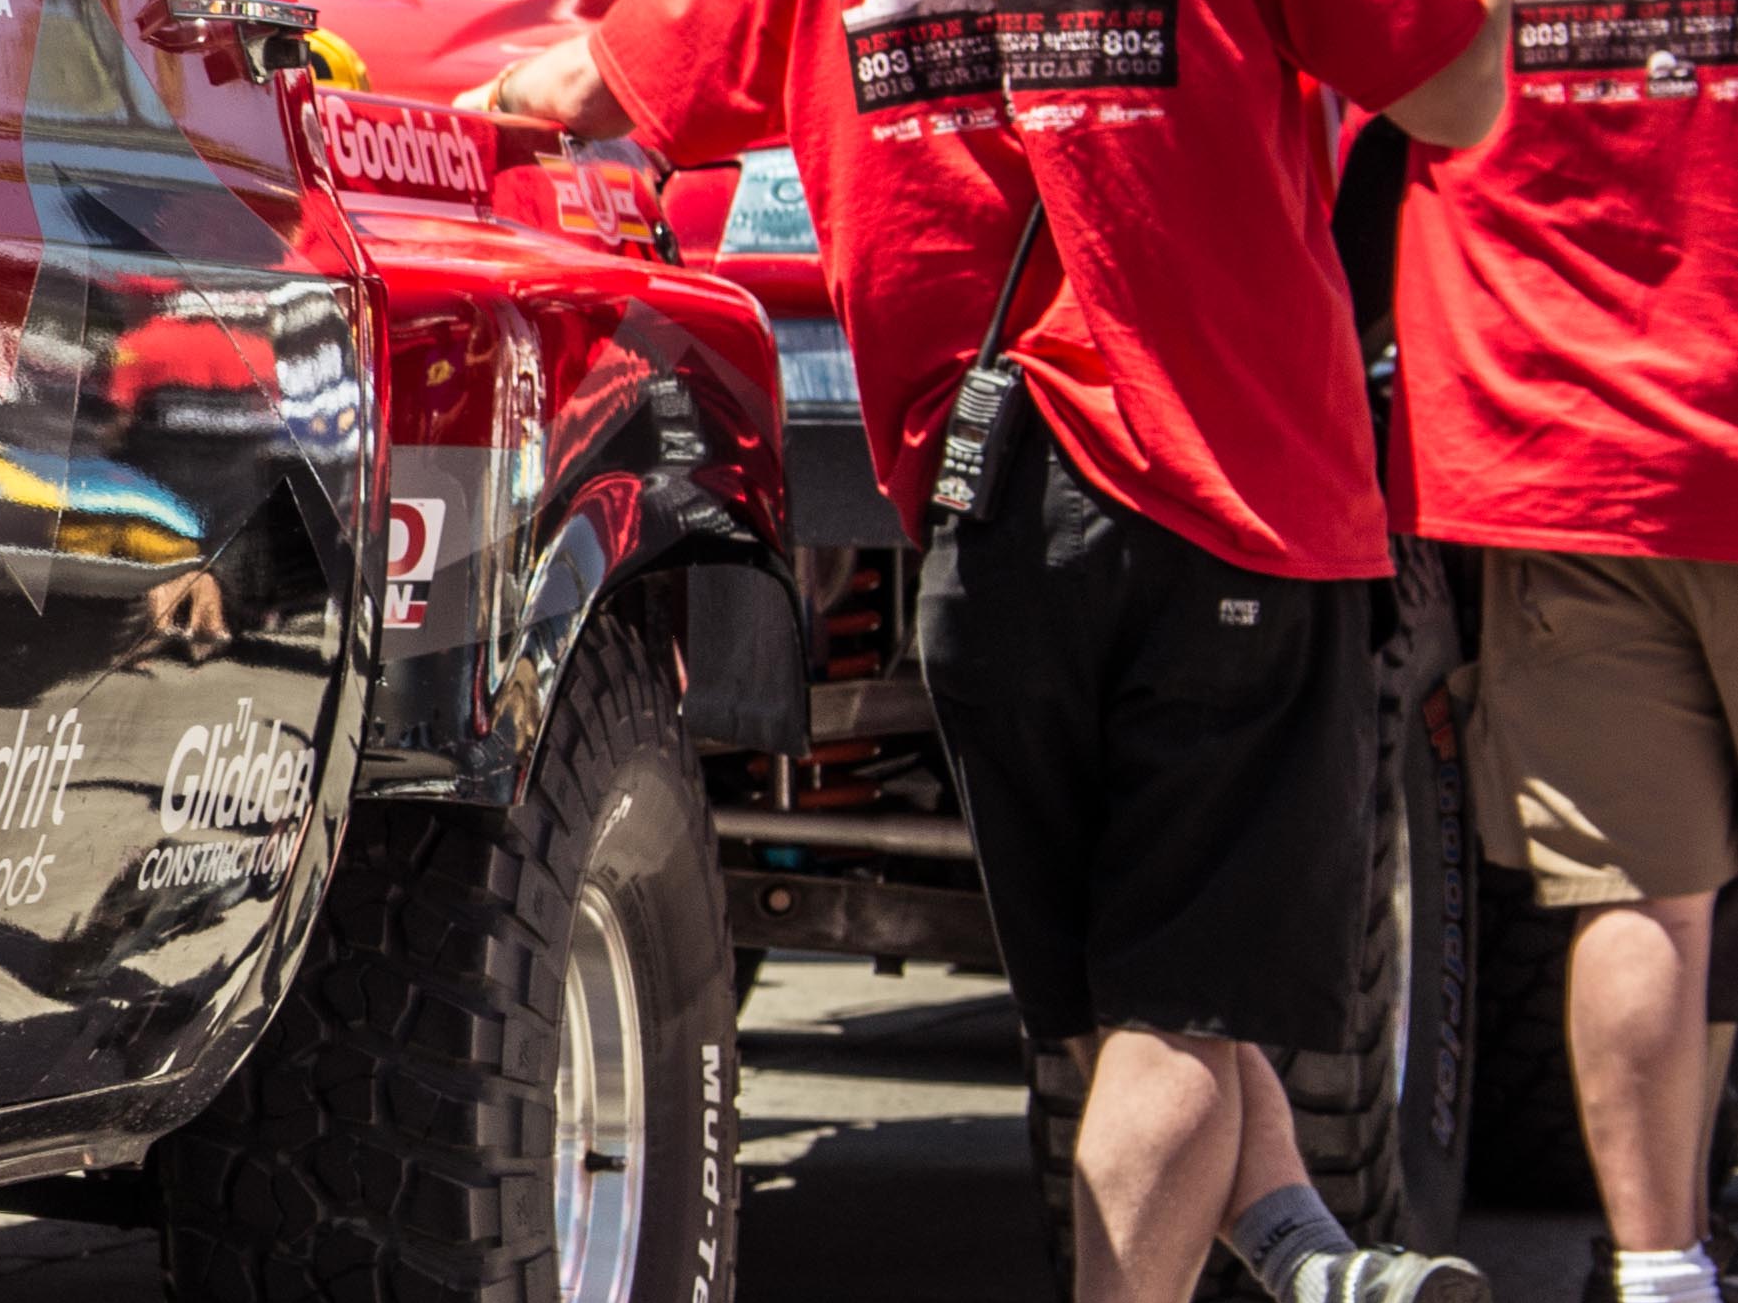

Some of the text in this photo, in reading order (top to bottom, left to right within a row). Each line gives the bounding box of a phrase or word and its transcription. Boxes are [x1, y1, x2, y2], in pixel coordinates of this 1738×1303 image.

[855, 18, 964, 56] RETURN
[1056, 9, 1164, 31] TITANS
[857, 48, 910, 83] 803
[1102, 29, 1164, 57] 804
[316, 94, 487, 193] Goodrich
[160, 719, 316, 834] Glidden
[138, 831, 298, 890] CONSTRUCTION
[1421, 686, 1465, 1148] BFGoodrich
